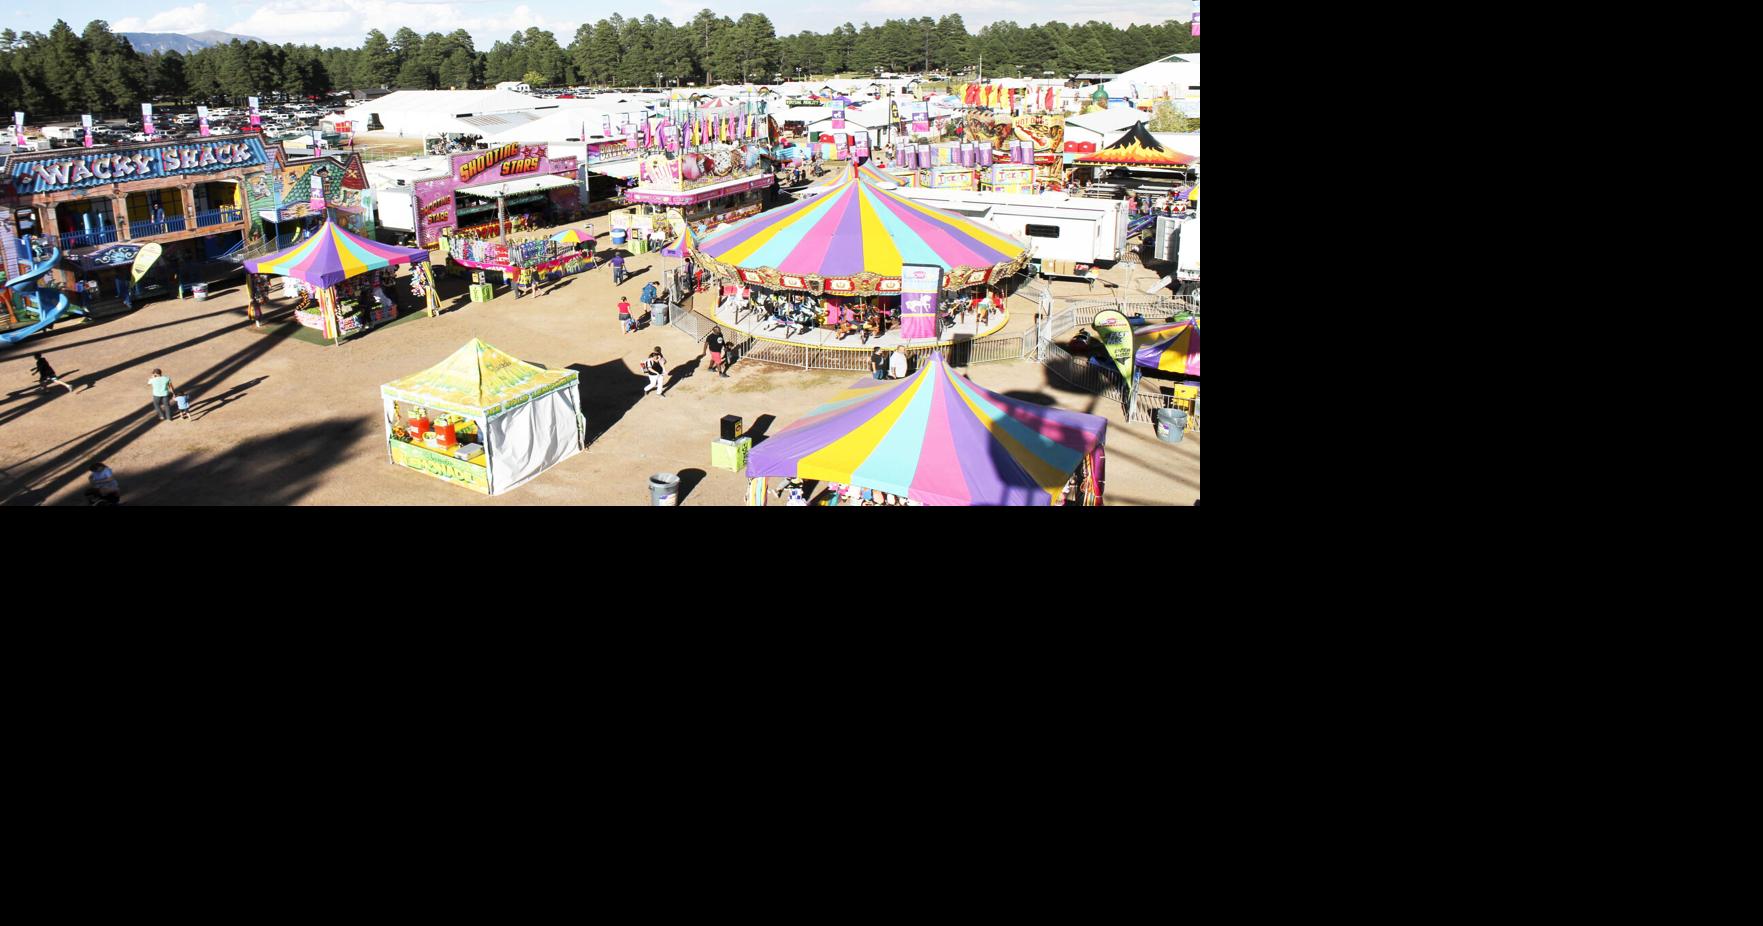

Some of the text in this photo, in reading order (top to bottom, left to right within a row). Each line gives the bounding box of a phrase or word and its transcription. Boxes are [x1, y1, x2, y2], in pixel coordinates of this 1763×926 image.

[1015, 116, 1049, 126] HOT DS
[33, 143, 252, 185] WACKY SHACK
[459, 142, 519, 183] SHOOTING
[500, 157, 539, 176] STARS
[420, 195, 451, 216] SHOOTING
[427, 211, 449, 225] STARS
